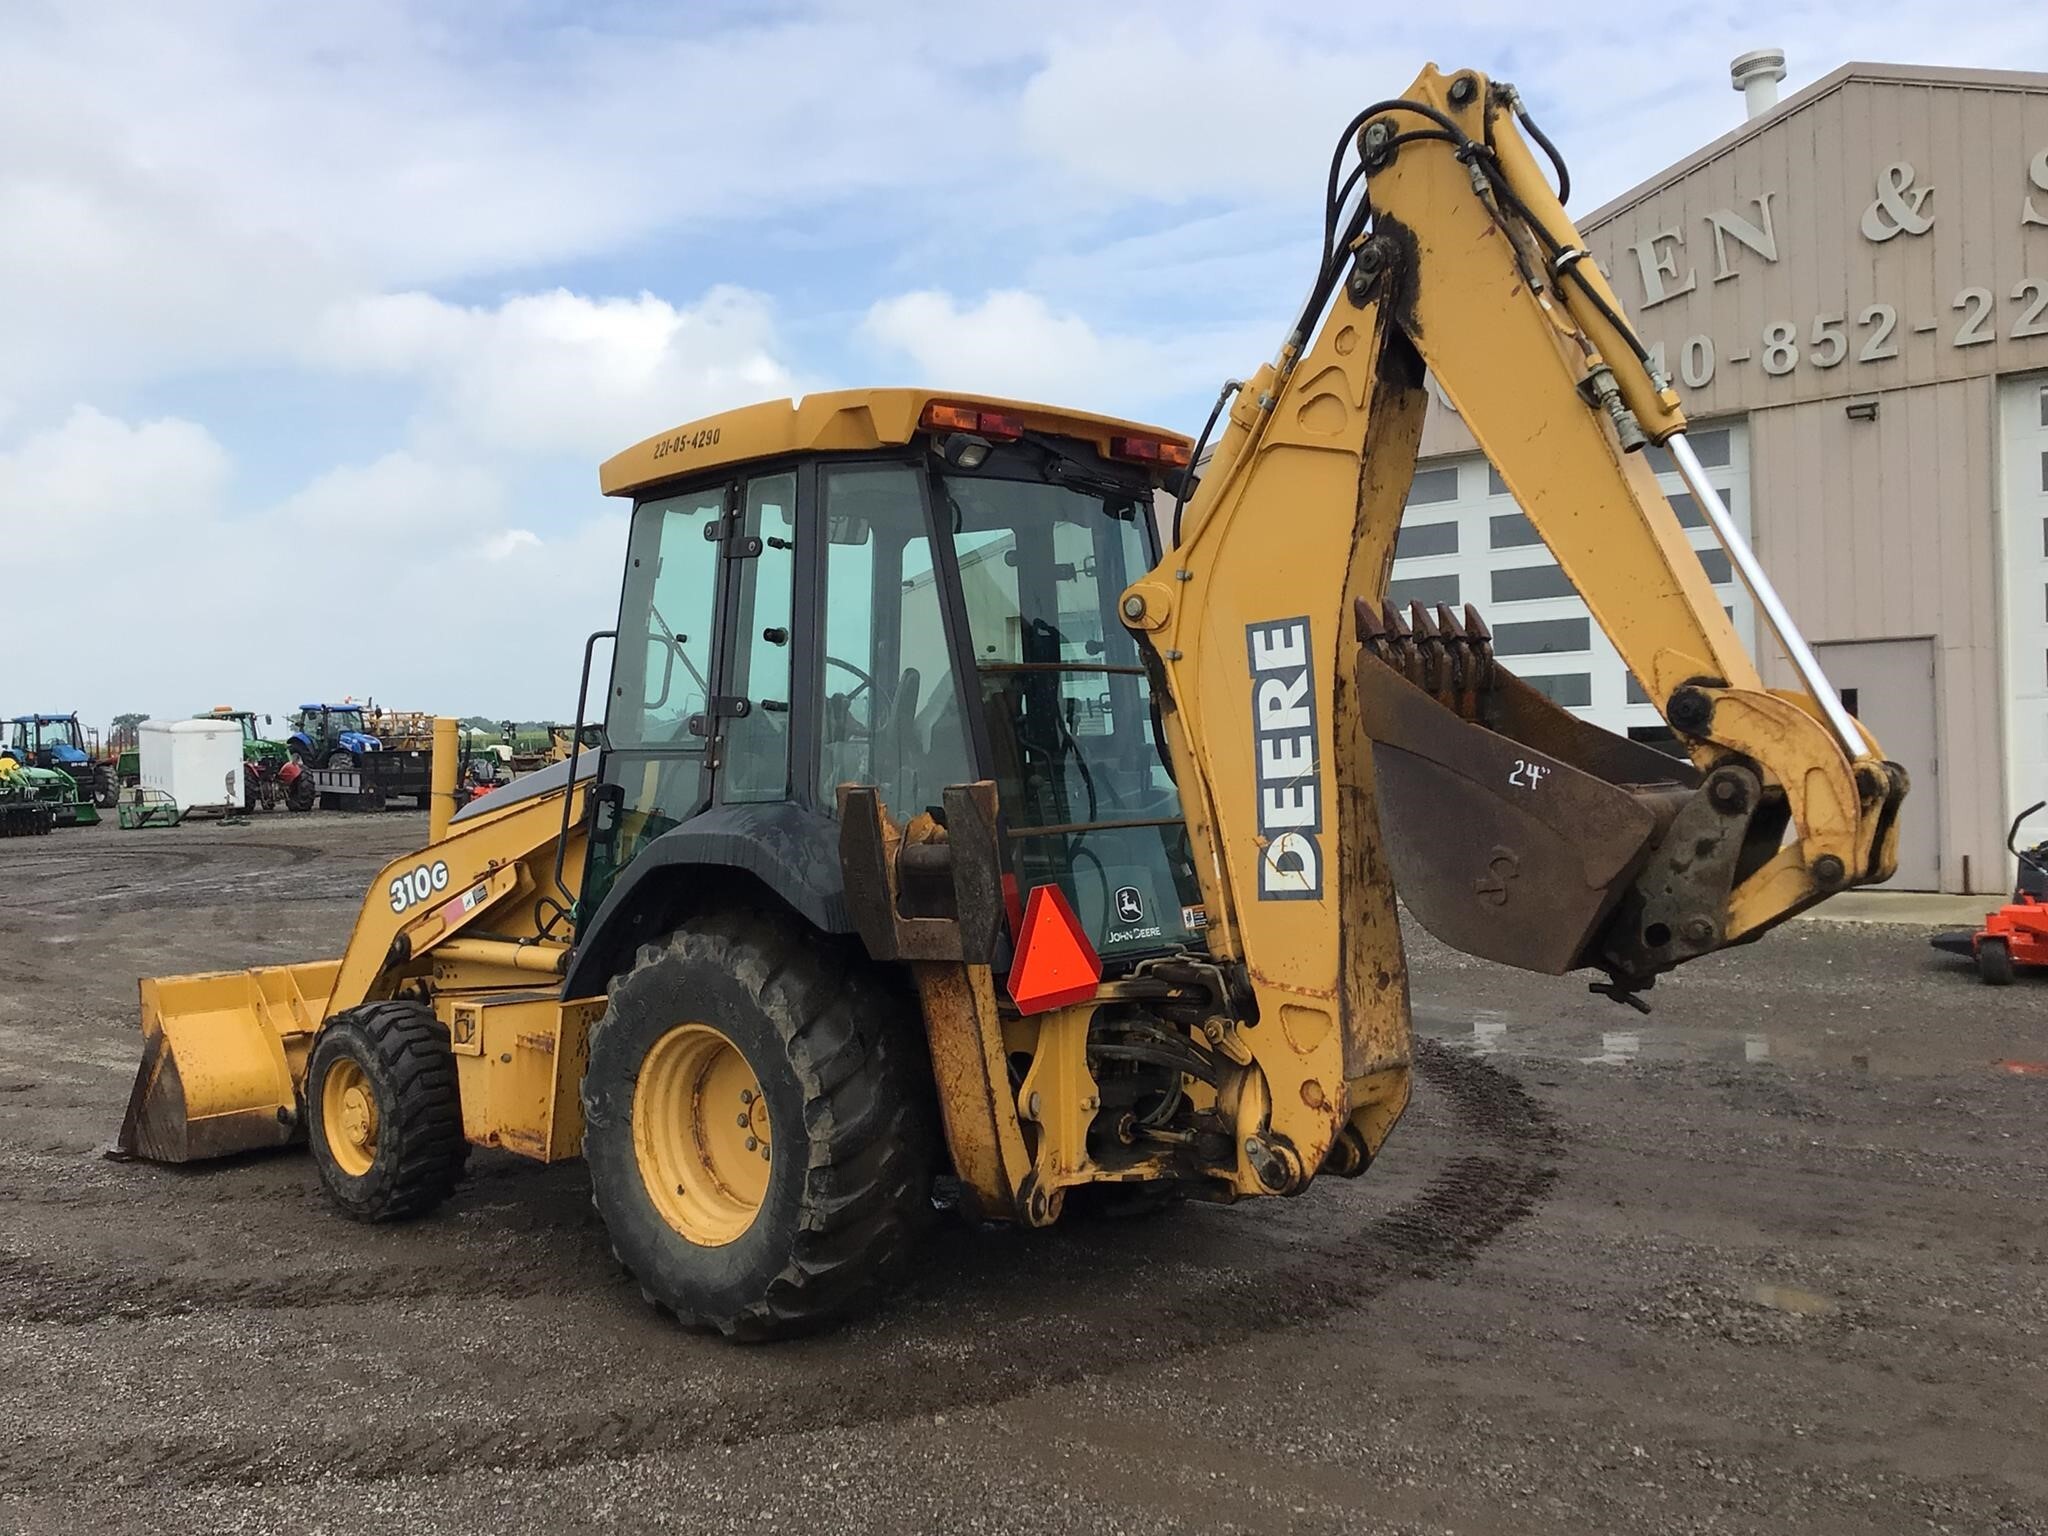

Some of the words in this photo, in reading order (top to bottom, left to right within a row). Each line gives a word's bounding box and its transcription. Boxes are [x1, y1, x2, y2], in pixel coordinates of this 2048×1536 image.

[1861, 162, 1936, 243] &
[653, 428, 720, 460] 221-05-4290
[1252, 623, 1317, 892] DEERE
[390, 862, 448, 913] 310G
[1108, 930, 1133, 944] JOHN
[1133, 926, 1161, 940] DEERE
